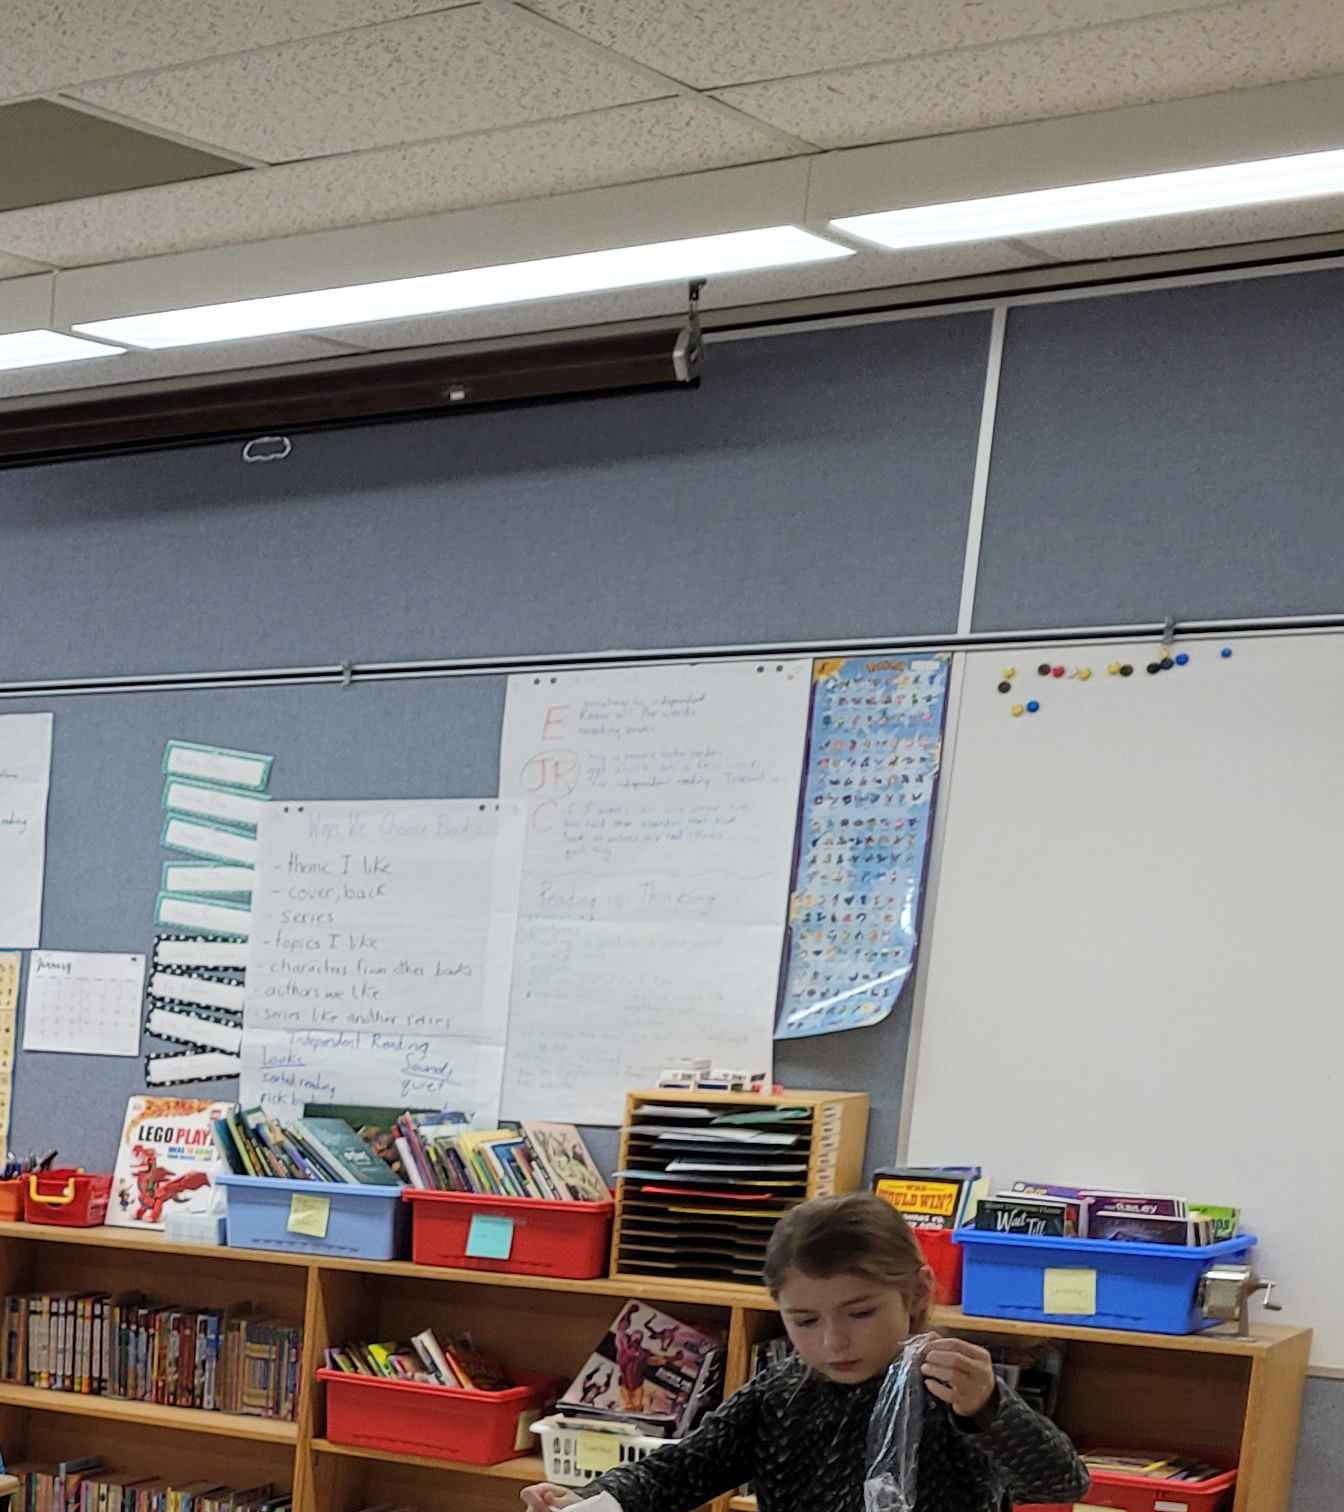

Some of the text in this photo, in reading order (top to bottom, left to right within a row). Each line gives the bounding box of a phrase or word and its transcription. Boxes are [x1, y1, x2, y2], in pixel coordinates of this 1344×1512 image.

[542, 705, 571, 741] E
[288, 851, 332, 874] theme
[341, 853, 352, 875] I
[281, 910, 334, 924] series
[138, 1124, 211, 1146] LEGO PLAY
[921, 1192, 953, 1212] WIN?
